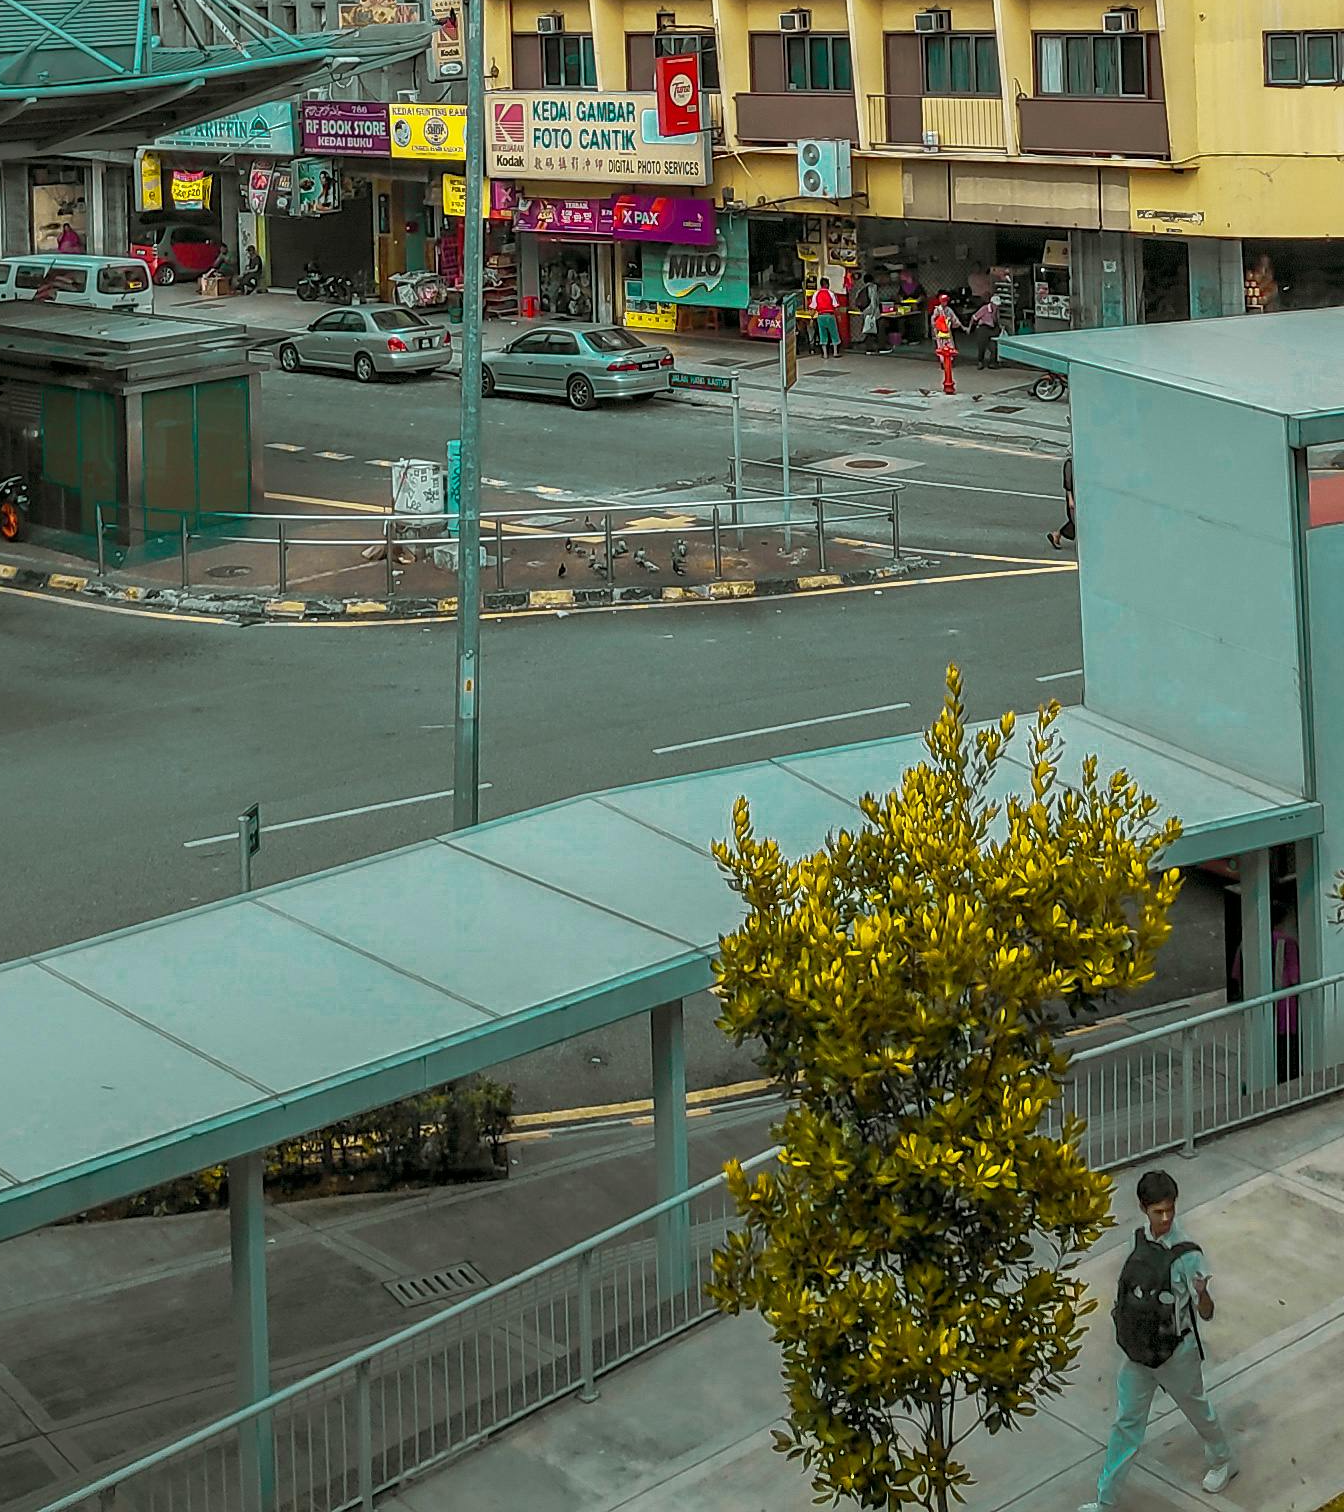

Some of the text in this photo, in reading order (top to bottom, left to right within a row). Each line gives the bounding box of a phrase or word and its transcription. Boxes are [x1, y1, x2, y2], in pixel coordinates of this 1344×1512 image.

[440, 49, 460, 57] Kodak
[392, 107, 415, 116] KEDAI
[532, 100, 636, 123] KEDAI GAMBAR
[194, 121, 248, 139] ARIFFIN
[305, 119, 387, 136] RF BOOK STORE
[318, 136, 373, 148] KEDAI BUKU
[533, 127, 638, 152] FOTO CANTIK
[496, 153, 525, 169] Kodak
[608, 159, 635, 174] DIGITAL
[637, 159, 661, 175] PHOTO
[663, 159, 700, 177] SERVICES
[668, 253, 722, 280] MILO
